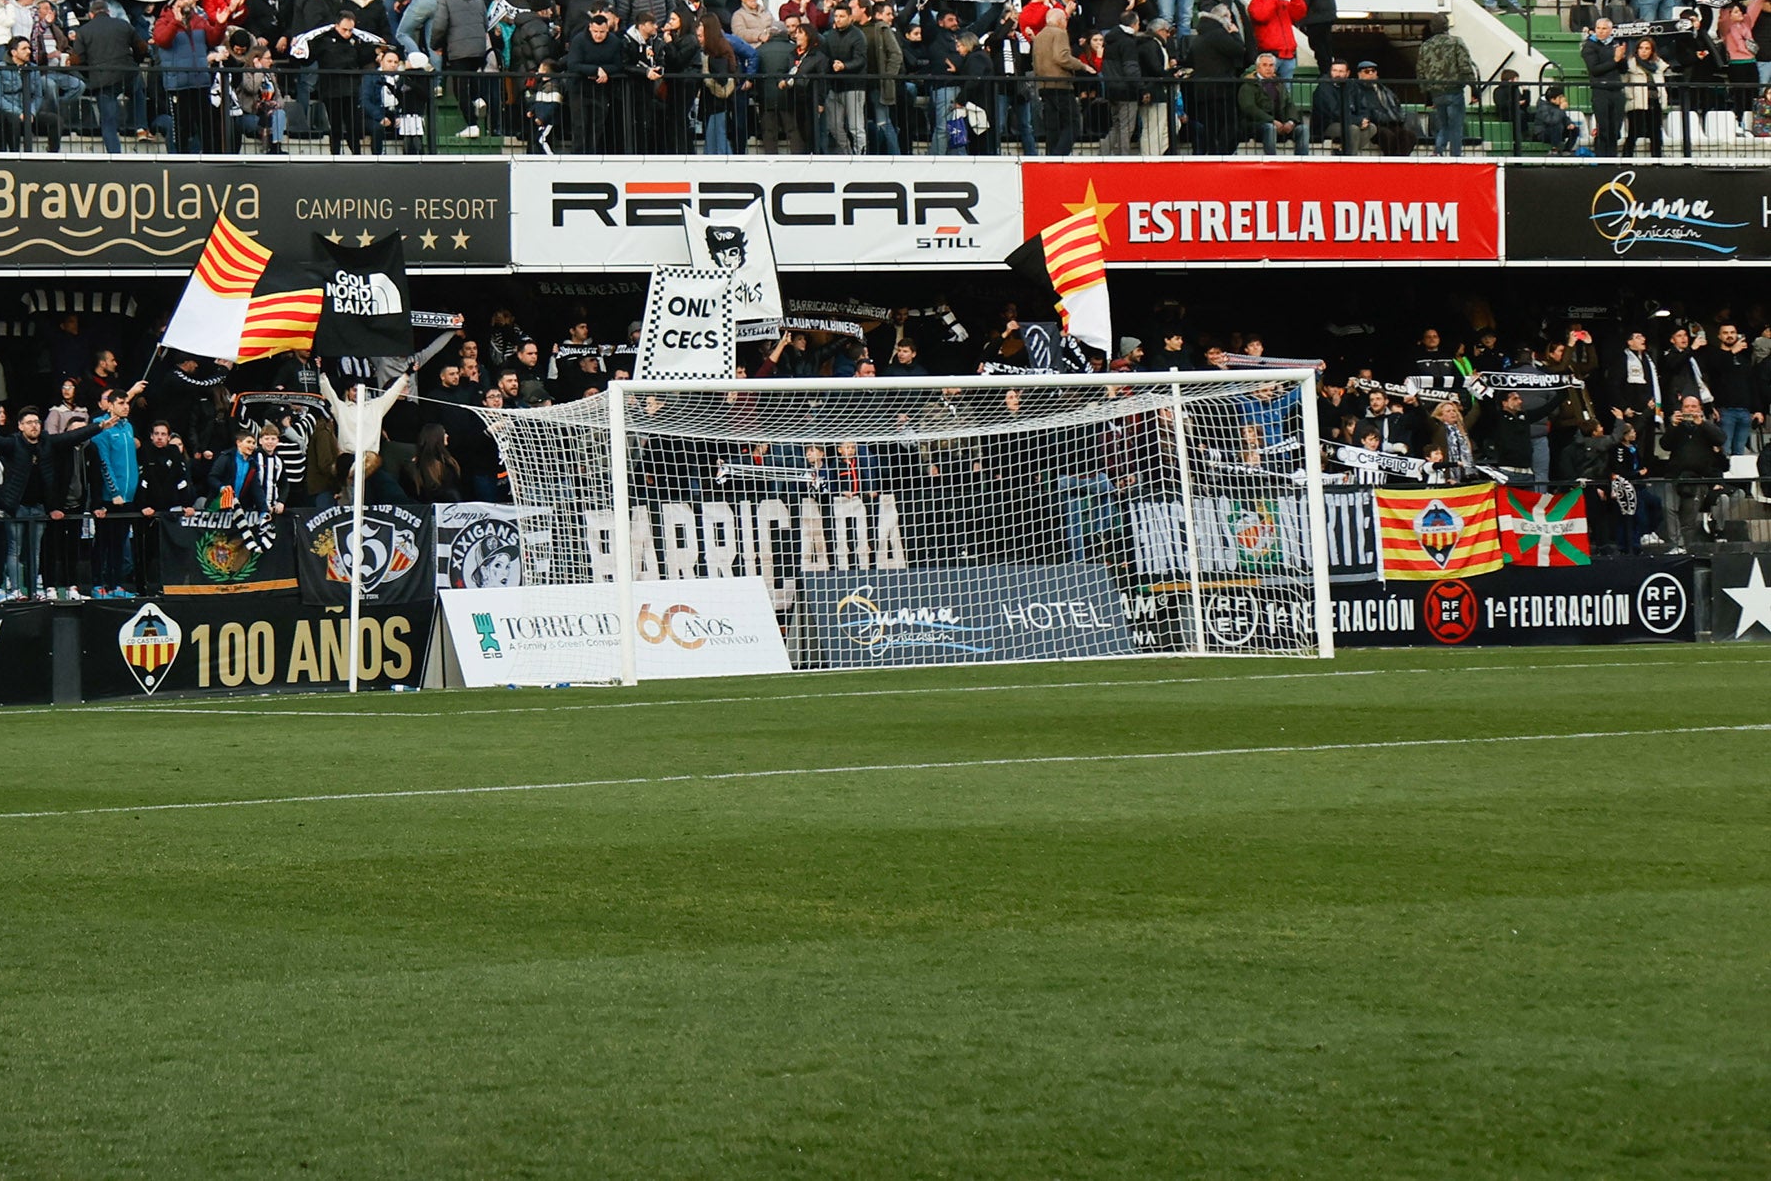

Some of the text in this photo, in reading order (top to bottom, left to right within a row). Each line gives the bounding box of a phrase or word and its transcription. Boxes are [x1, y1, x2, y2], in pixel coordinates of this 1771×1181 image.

[295, 197, 498, 221] CAMPING RESORT
[552, 181, 979, 227] REPCAR
[1127, 199, 1460, 244] ESTRELLA DAMM
[916, 237, 981, 249] STILL
[334, 270, 371, 289] GOL
[325, 283, 372, 303] NORD
[333, 297, 374, 316] BAIX
[662, 329, 719, 350] CECS
[735, 325, 778, 338] ASTELLON
[1385, 381, 1450, 401] CASLLON
[306, 505, 344, 532] NORTH
[394, 505, 423, 529] BOYS
[1647, 585, 1676, 601] RF
[1441, 600, 1459, 609] RF
[1508, 588, 1630, 629] FEDERACIÓN
[1647, 604, 1676, 621] EF
[499, 613, 622, 637] TORRECID
[1001, 601, 1113, 634] HOTEL
[1441, 611, 1459, 621] EF
[189, 605, 413, 689] 100 AÑOS
